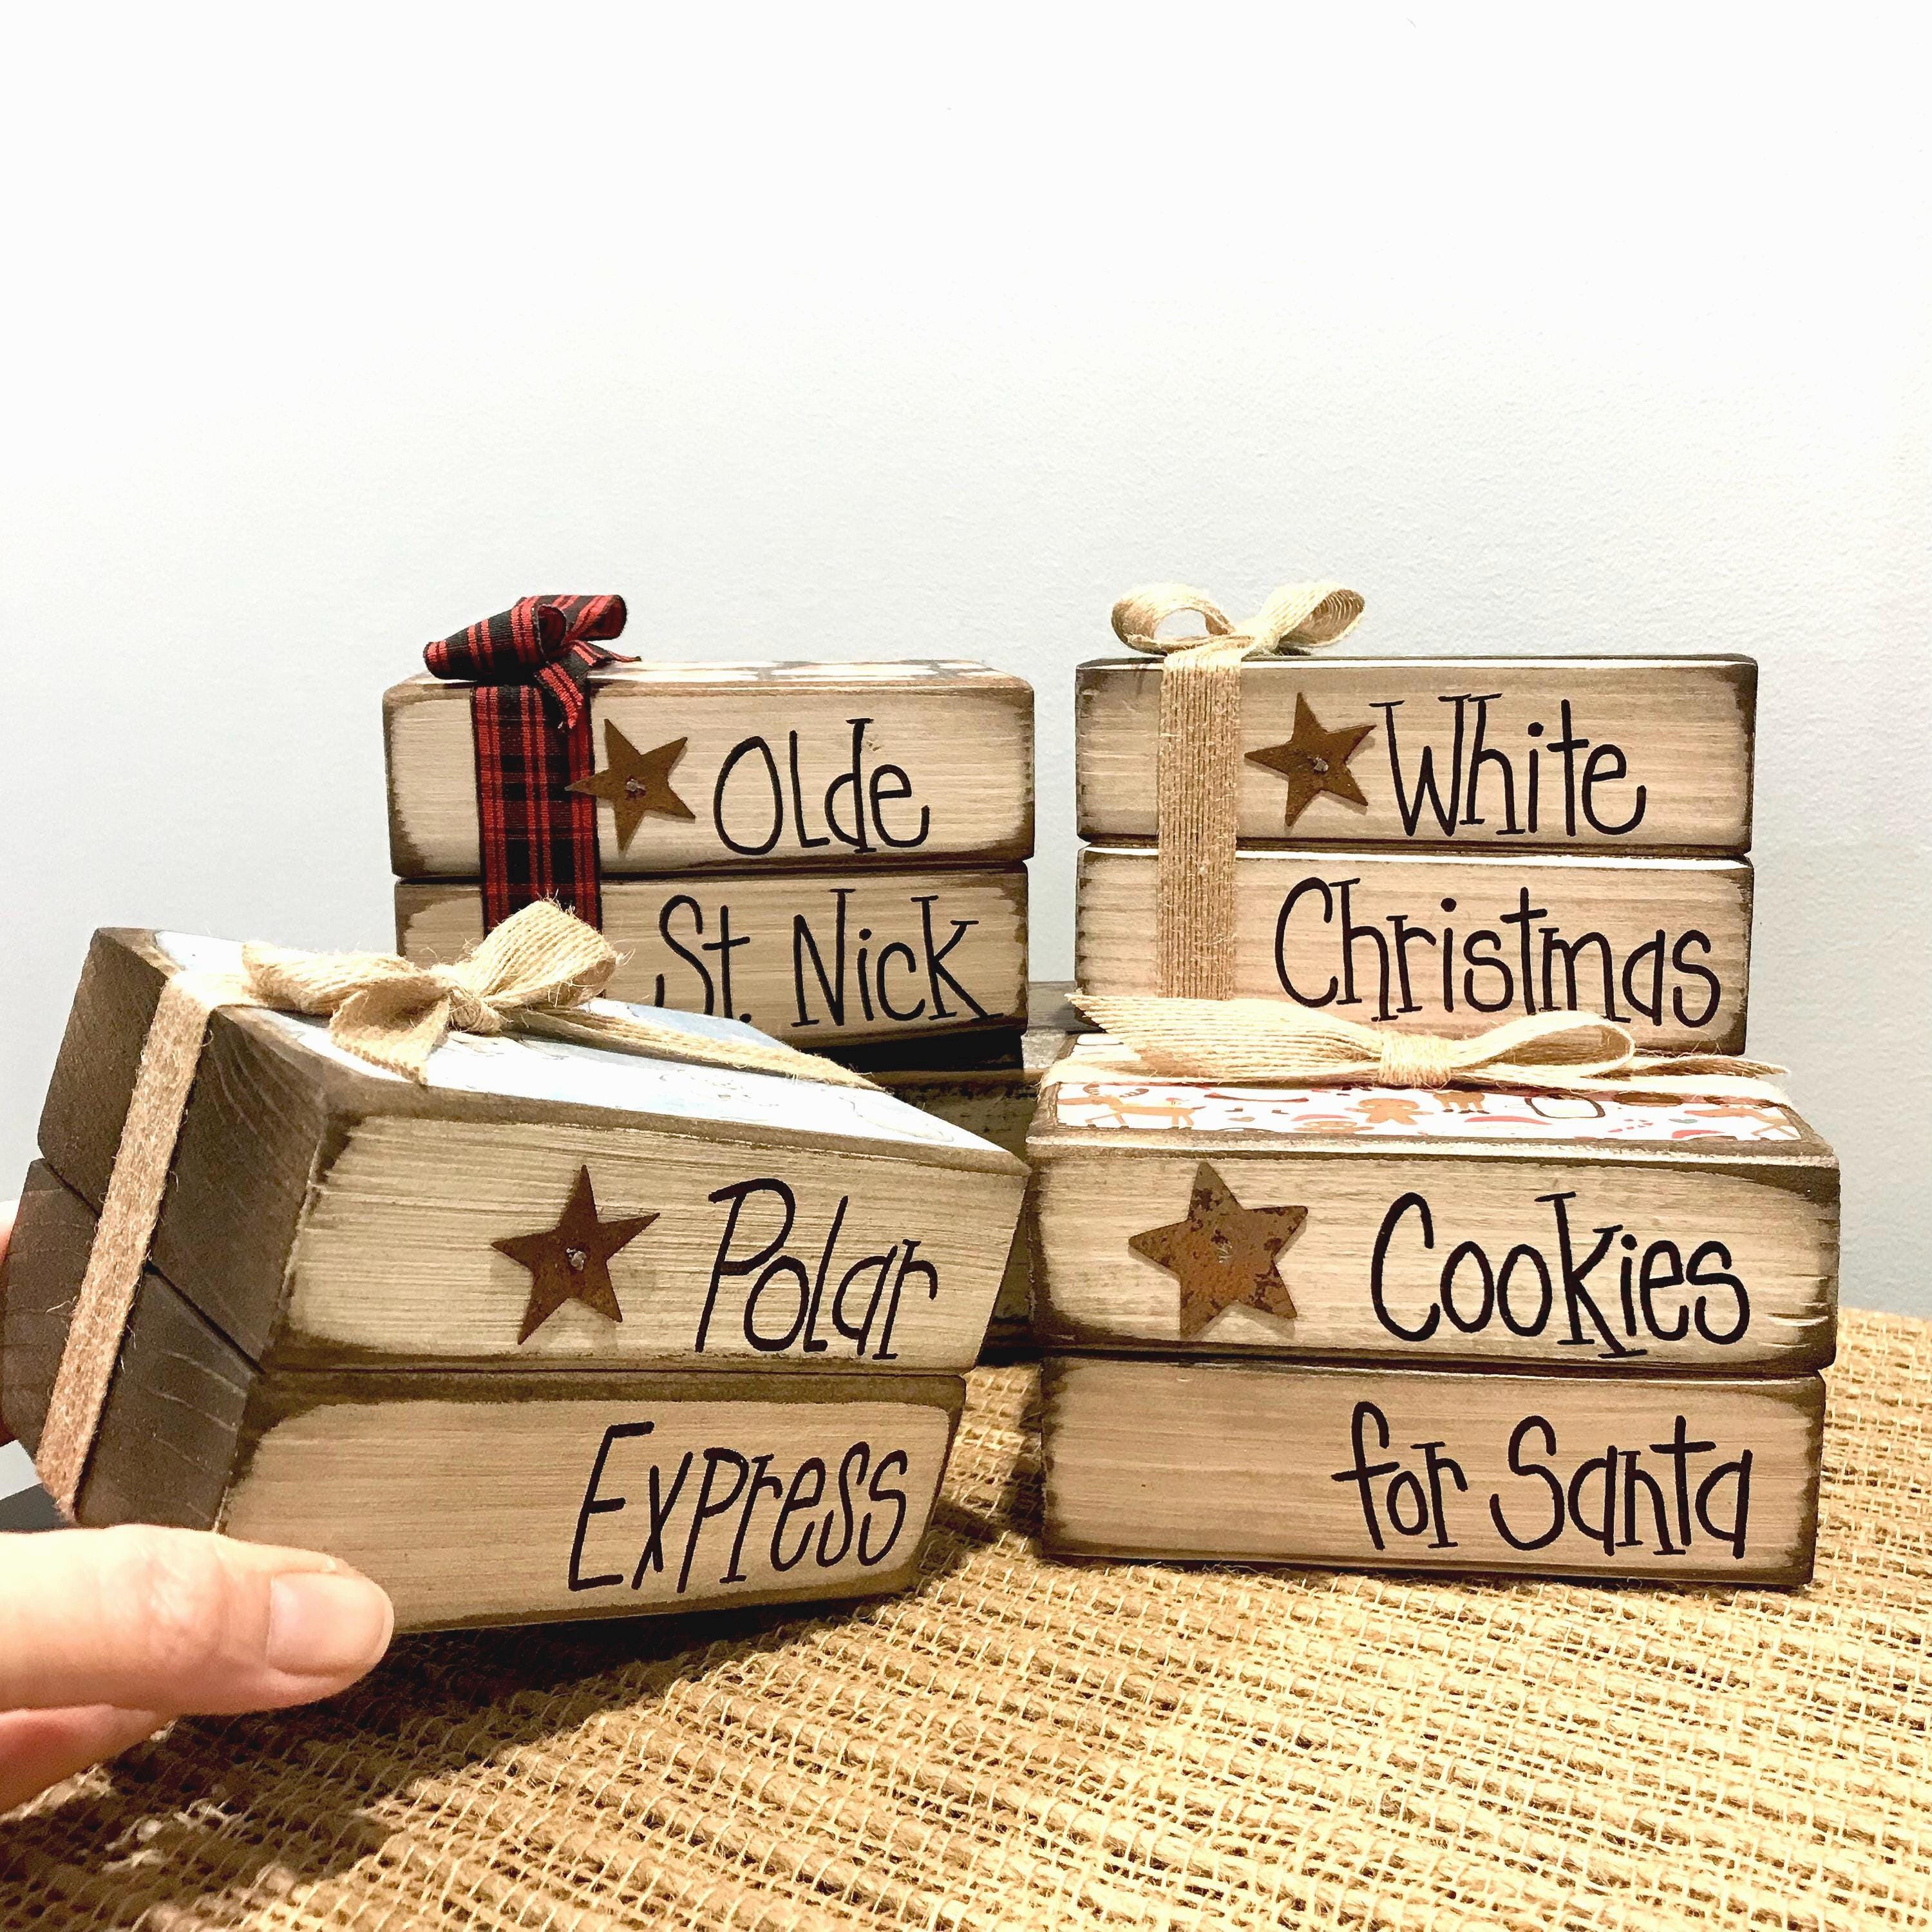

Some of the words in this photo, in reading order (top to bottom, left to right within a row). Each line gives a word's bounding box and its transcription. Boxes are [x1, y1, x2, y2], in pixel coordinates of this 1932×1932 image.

[1369, 693, 1646, 837] White
[655, 895, 752, 1023] St.
[791, 889, 1003, 1027] Nick
[1274, 876, 1720, 1027] Christmas
[1371, 1191, 1750, 1358] Cookies
[1331, 1401, 1468, 1551] for
[1490, 1415, 1753, 1559] Santa
